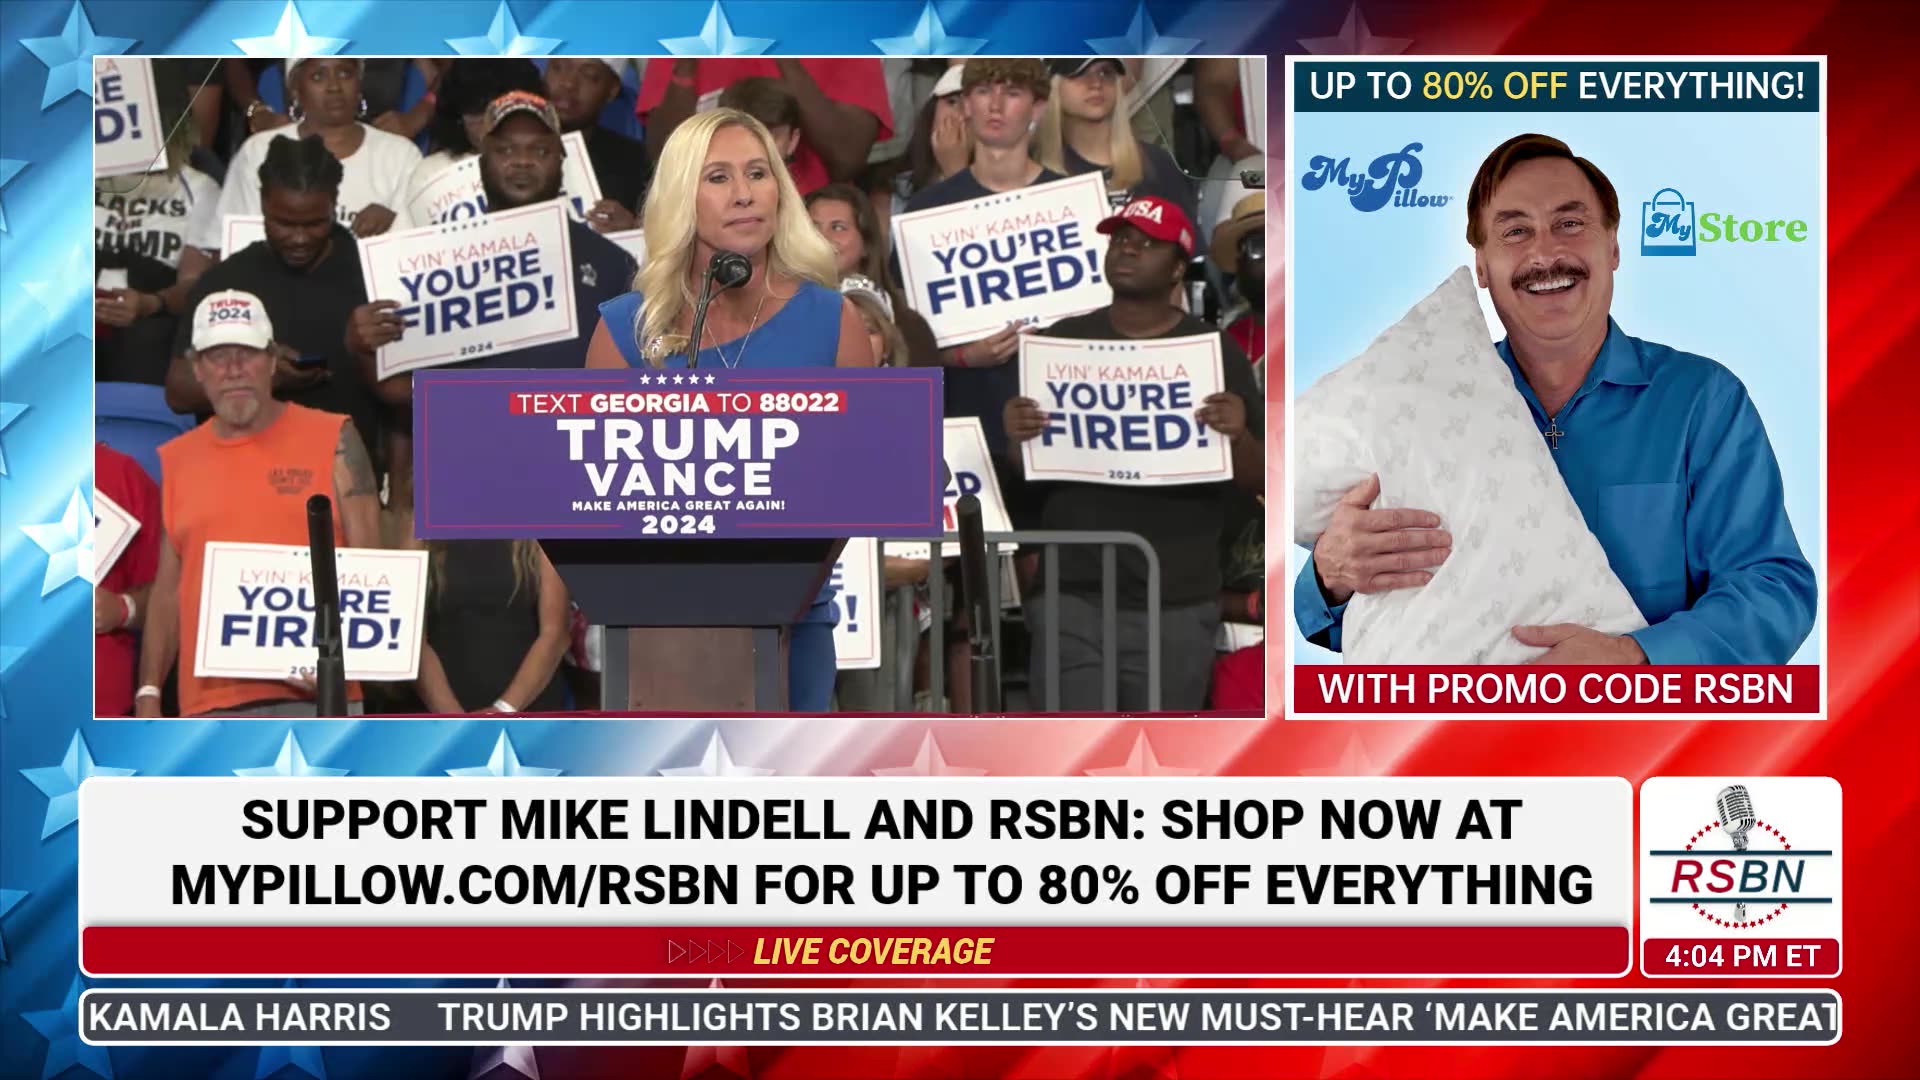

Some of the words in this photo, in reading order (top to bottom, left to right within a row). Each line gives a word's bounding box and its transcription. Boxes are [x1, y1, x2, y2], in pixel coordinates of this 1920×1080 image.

[986, 205, 1076, 235] KAMALA
[453, 231, 538, 262] KAMALA
[932, 221, 1083, 275] YOU'RE
[399, 247, 542, 303] YOU'RE
[926, 248, 1102, 316] FIRED!
[208, 297, 251, 310] TRUMP
[208, 308, 252, 322] 2024
[460, 341, 493, 356] 2024
[1099, 363, 1190, 382] KAMALA
[516, 393, 583, 414] TEXT
[590, 392, 711, 414] GEORGIA
[717, 392, 752, 413] TO
[759, 392, 840, 413] 88022
[1046, 380, 1193, 412] YOU'RE
[556, 417, 800, 461] TRUMP
[1041, 410, 1209, 452] FIRED!
[584, 461, 772, 497] VANCE
[1108, 469, 1142, 481] 2024
[572, 500, 612, 511] MAKE
[616, 500, 681, 511] AMERICA
[685, 500, 731, 511] GREAT
[735, 500, 786, 511] AGAIN!
[641, 514, 716, 535] 2024
[299, 570, 392, 588] KMALA
[238, 585, 392, 614] YOURE
[220, 613, 402, 650] FIRD!
